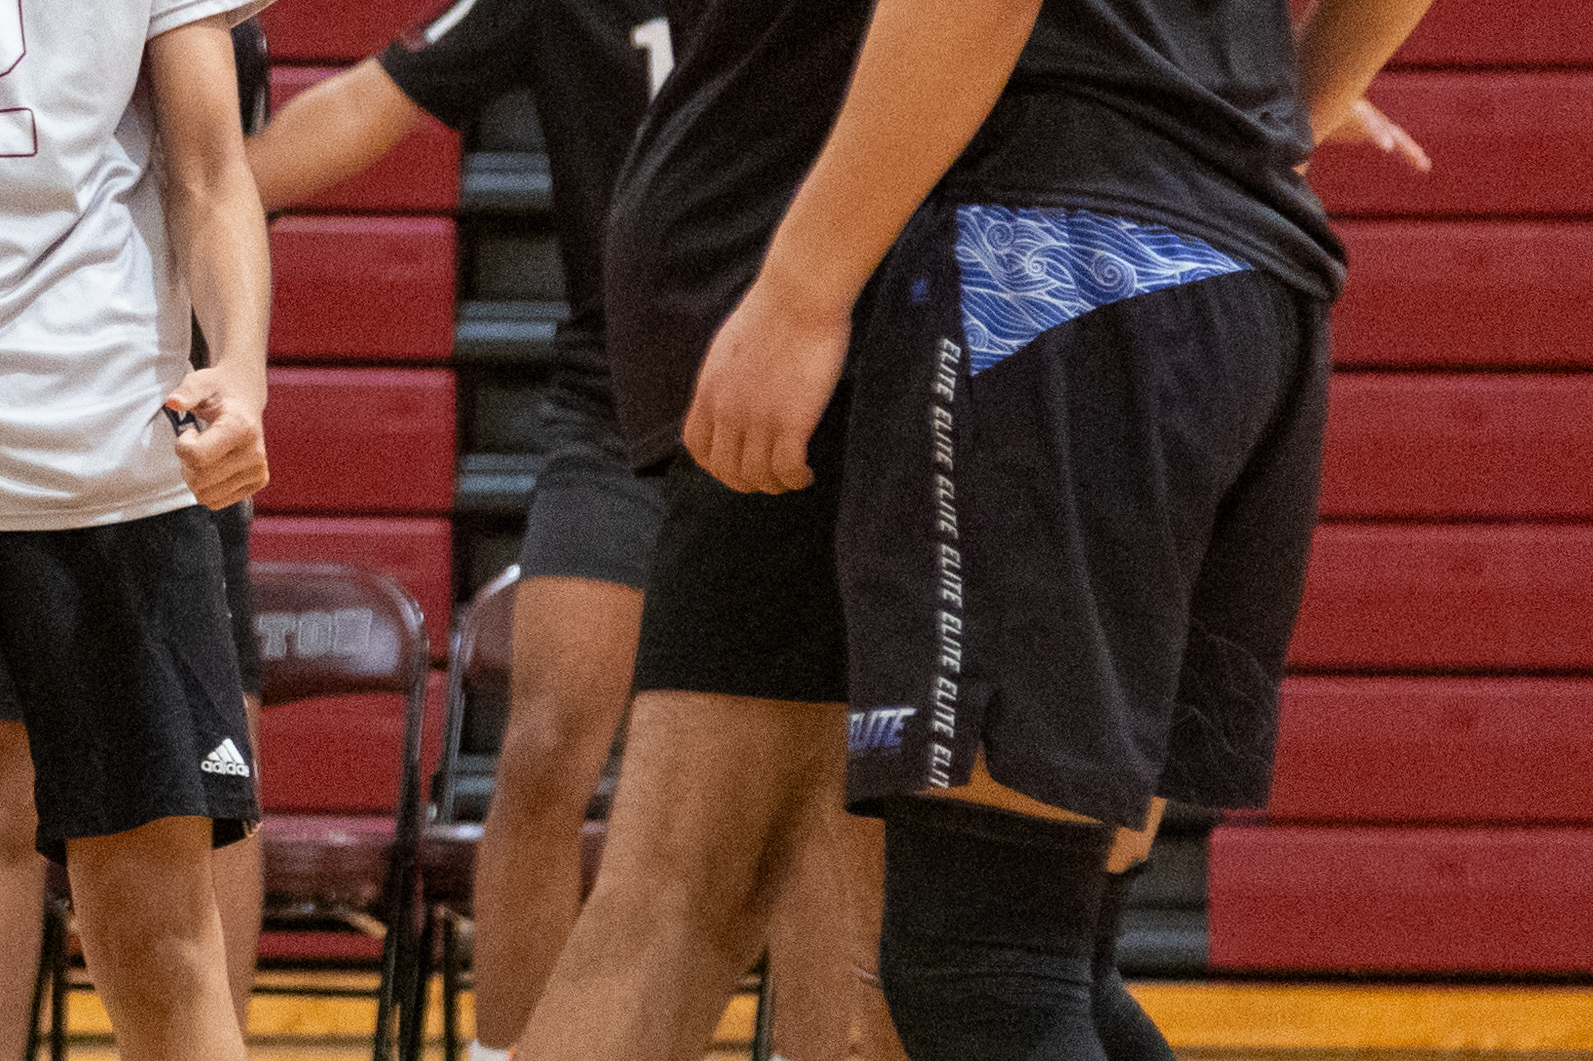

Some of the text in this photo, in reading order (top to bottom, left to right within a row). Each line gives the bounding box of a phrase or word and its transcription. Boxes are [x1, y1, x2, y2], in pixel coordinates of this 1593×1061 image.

[935, 338, 961, 402] ELITE
[932, 406, 953, 470] ELITE
[937, 474, 958, 539] ELITE
[940, 544, 963, 609] ELITE
[940, 611, 962, 673] ELITE
[934, 676, 958, 738] ELITE
[201, 760, 250, 778] adidas
